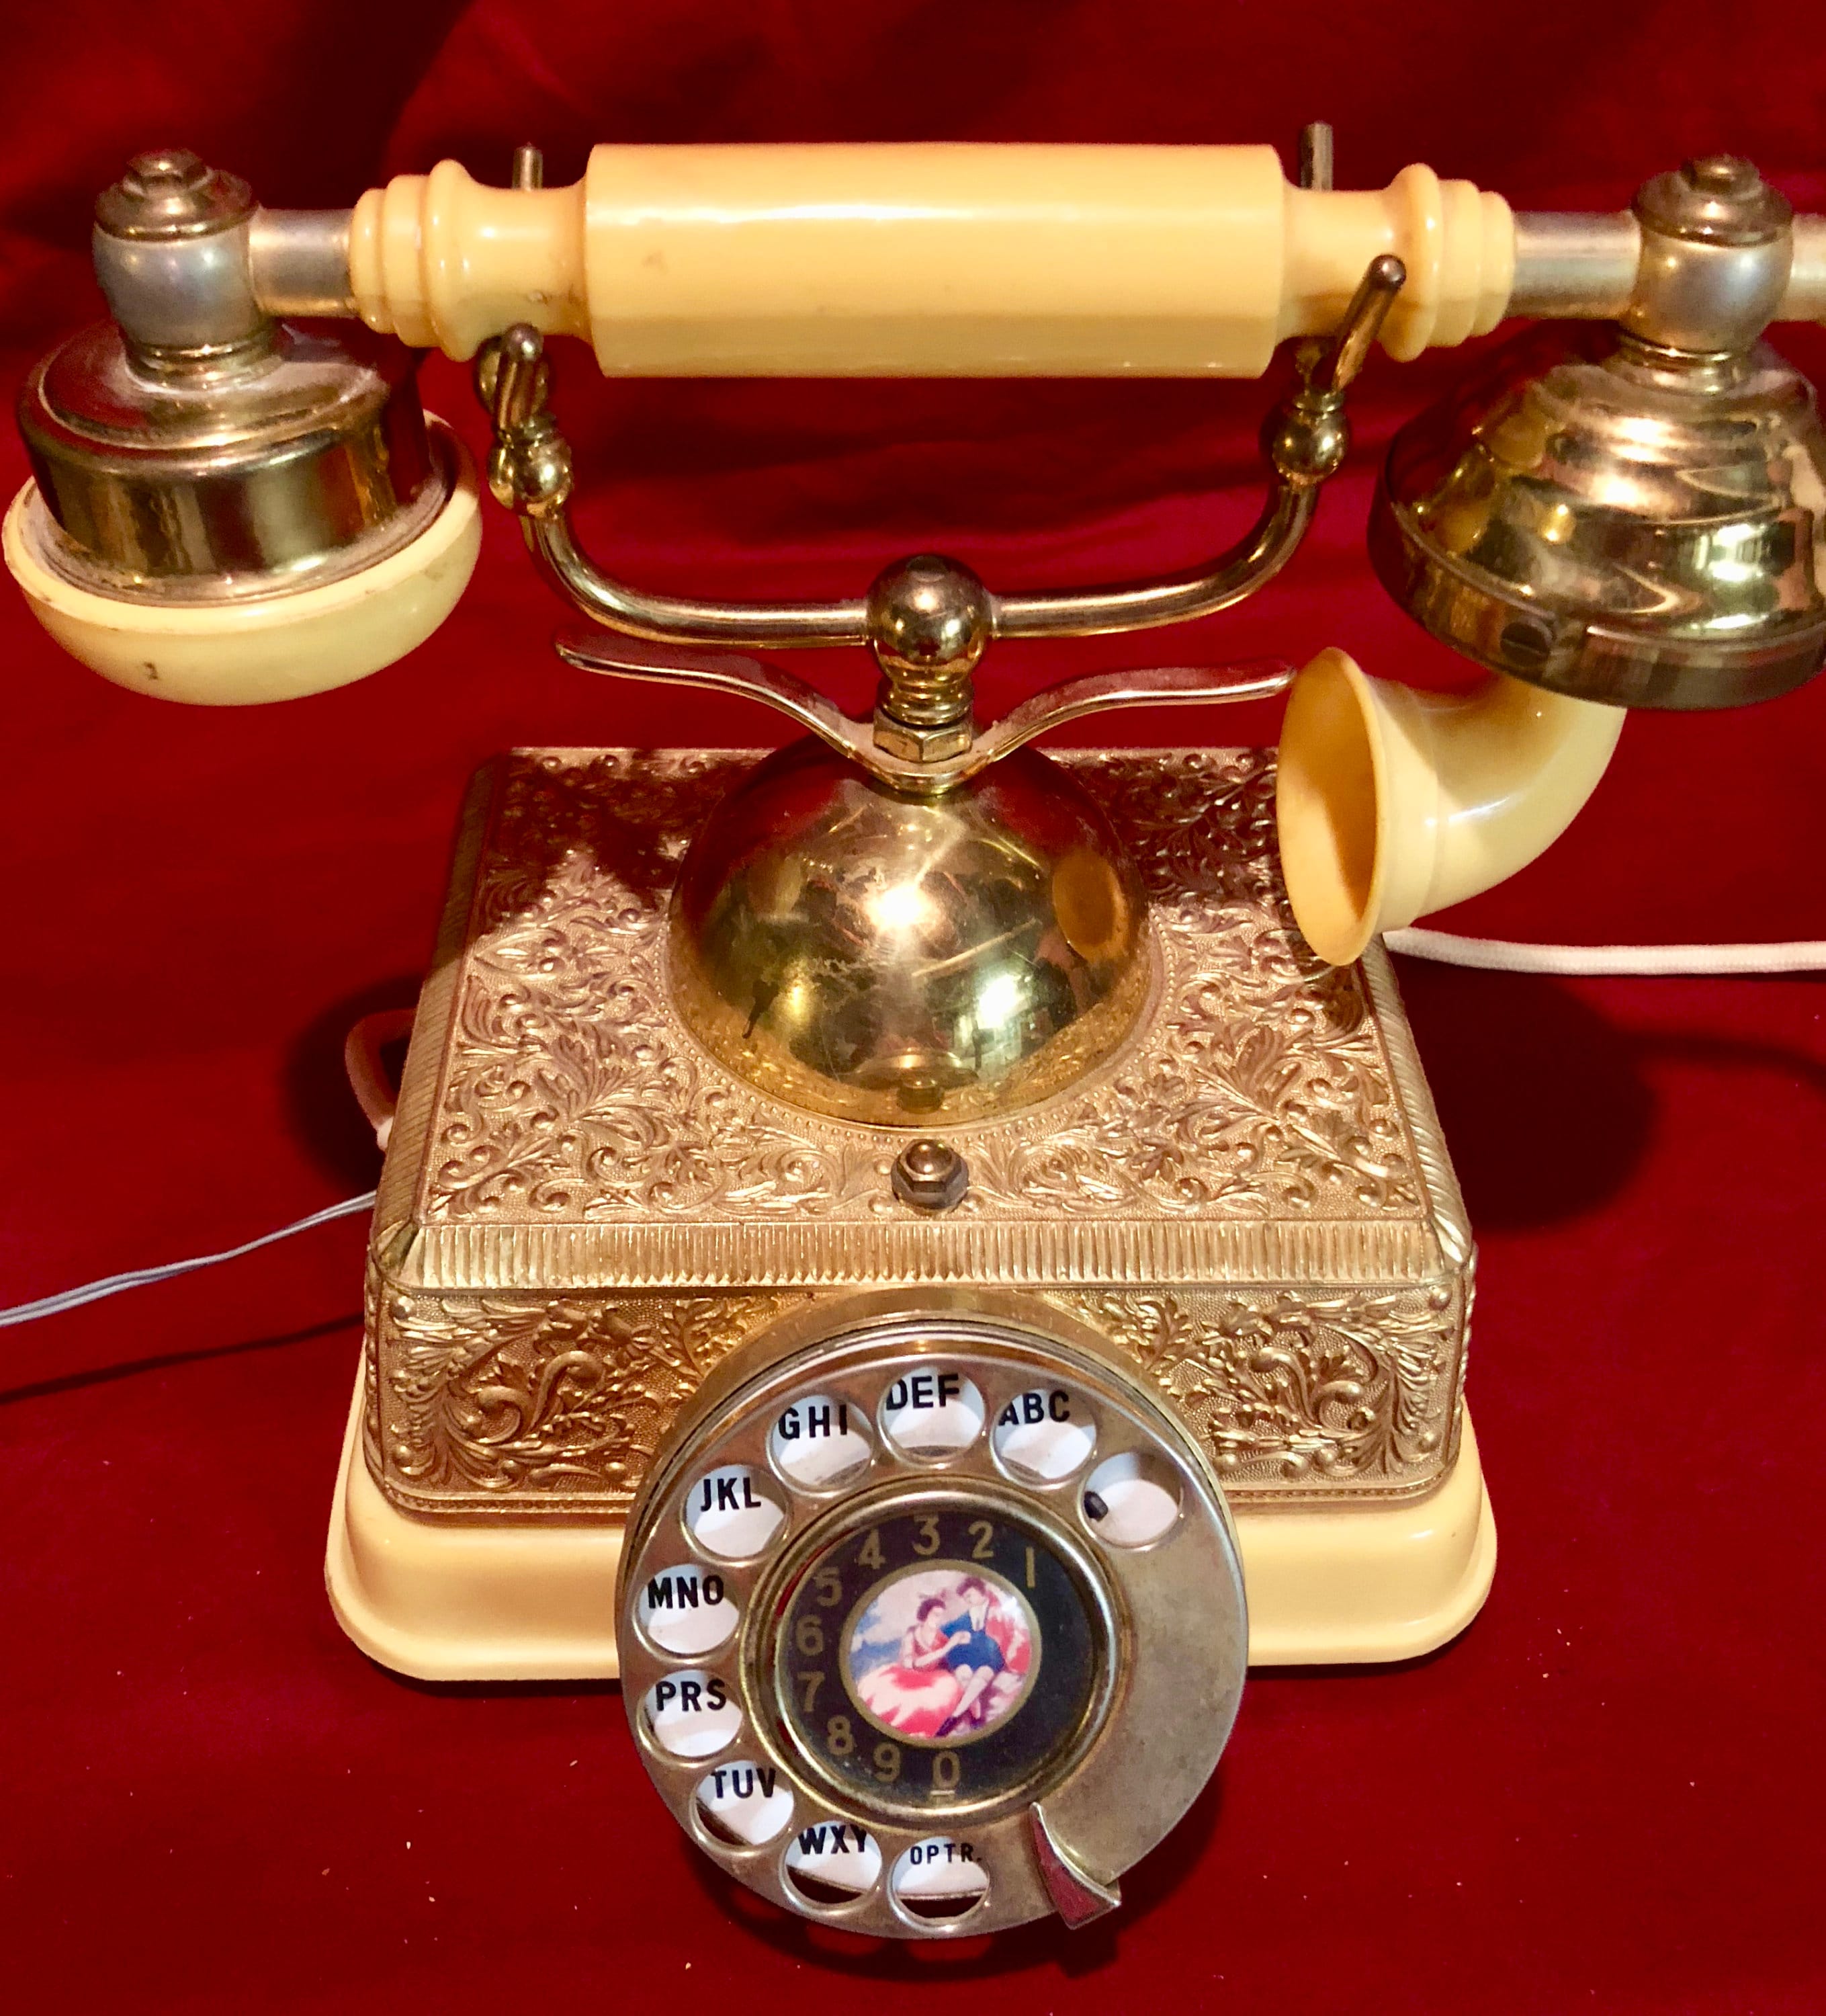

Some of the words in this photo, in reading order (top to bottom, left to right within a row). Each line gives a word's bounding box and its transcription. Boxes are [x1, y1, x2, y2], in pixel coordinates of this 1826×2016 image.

[886, 1374, 959, 1411] DEF
[998, 1390, 1070, 1426] ABC
[778, 1404, 848, 1439] GHI
[701, 1476, 761, 1511] JKL
[858, 1529, 886, 1570] 4
[912, 1515, 941, 1556] 3
[968, 1521, 994, 1559] 2
[1025, 1546, 1036, 1588] 1
[647, 1575, 724, 1609] MNO
[812, 1566, 843, 1607] 5
[796, 1615, 824, 1656] 6
[655, 1679, 727, 1712] PRS
[797, 1671, 825, 1712] 7
[826, 1716, 857, 1756] 8
[873, 1742, 902, 1783] 9
[932, 1751, 961, 1790] 0
[711, 1767, 776, 1799] TUV
[797, 1823, 867, 1855] WXY
